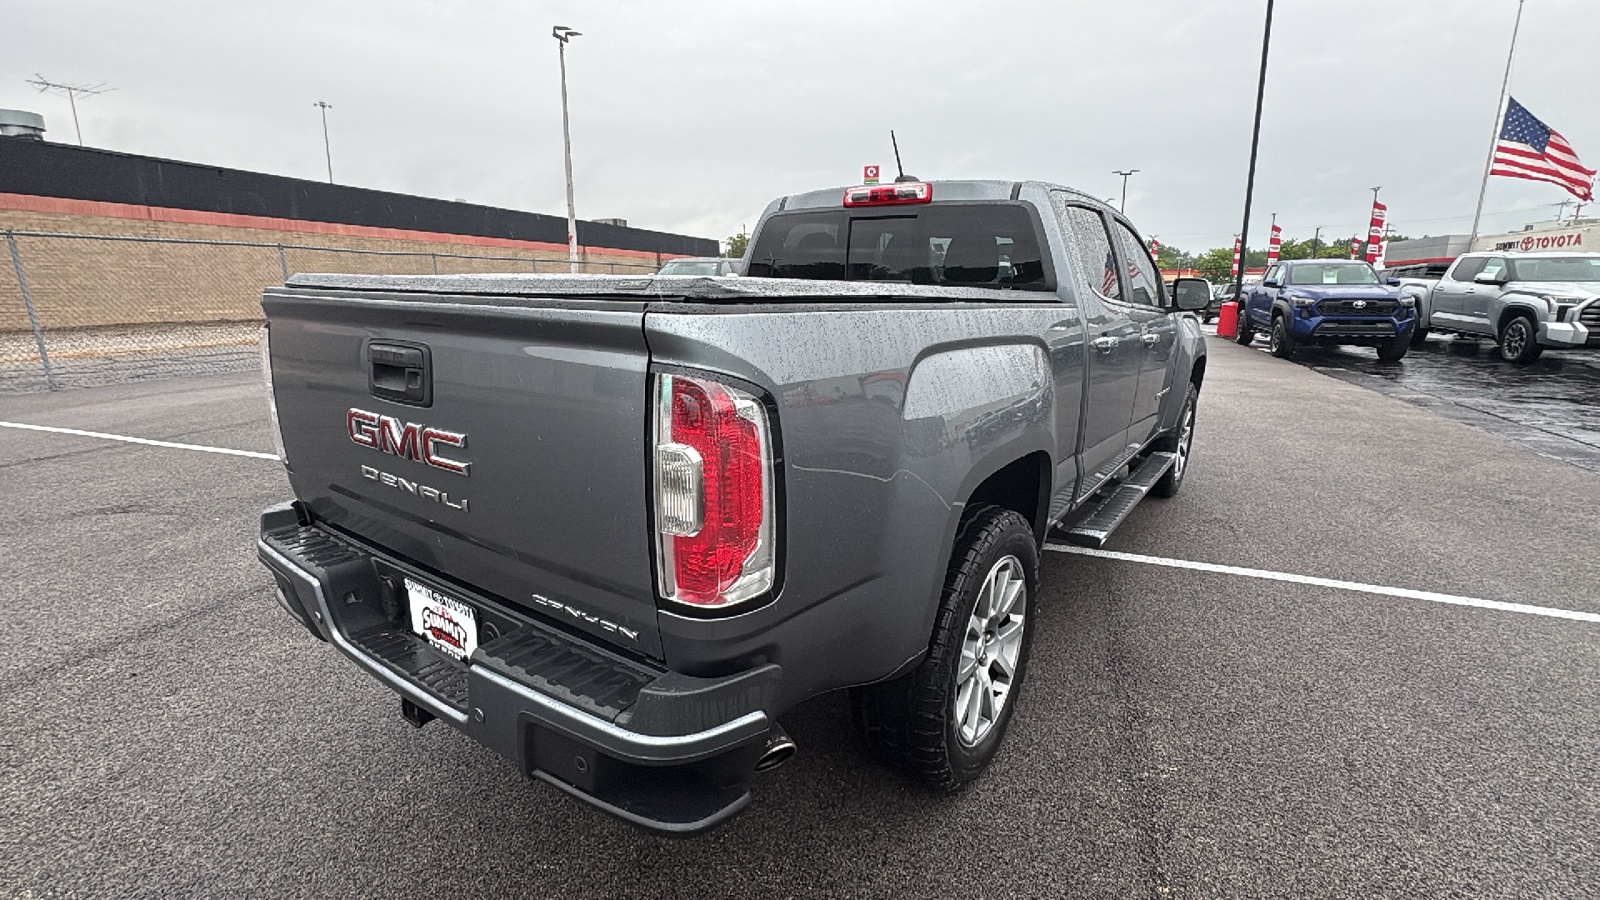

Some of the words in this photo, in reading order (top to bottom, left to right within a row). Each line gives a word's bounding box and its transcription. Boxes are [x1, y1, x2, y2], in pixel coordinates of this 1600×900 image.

[1495, 240, 1520, 251] SUMMIT
[1535, 233, 1582, 249] TOYOTA
[346, 407, 472, 477] GMC
[361, 464, 470, 513] DENALI
[422, 606, 467, 652] SUMMIT
[532, 593, 639, 642] CANYON
